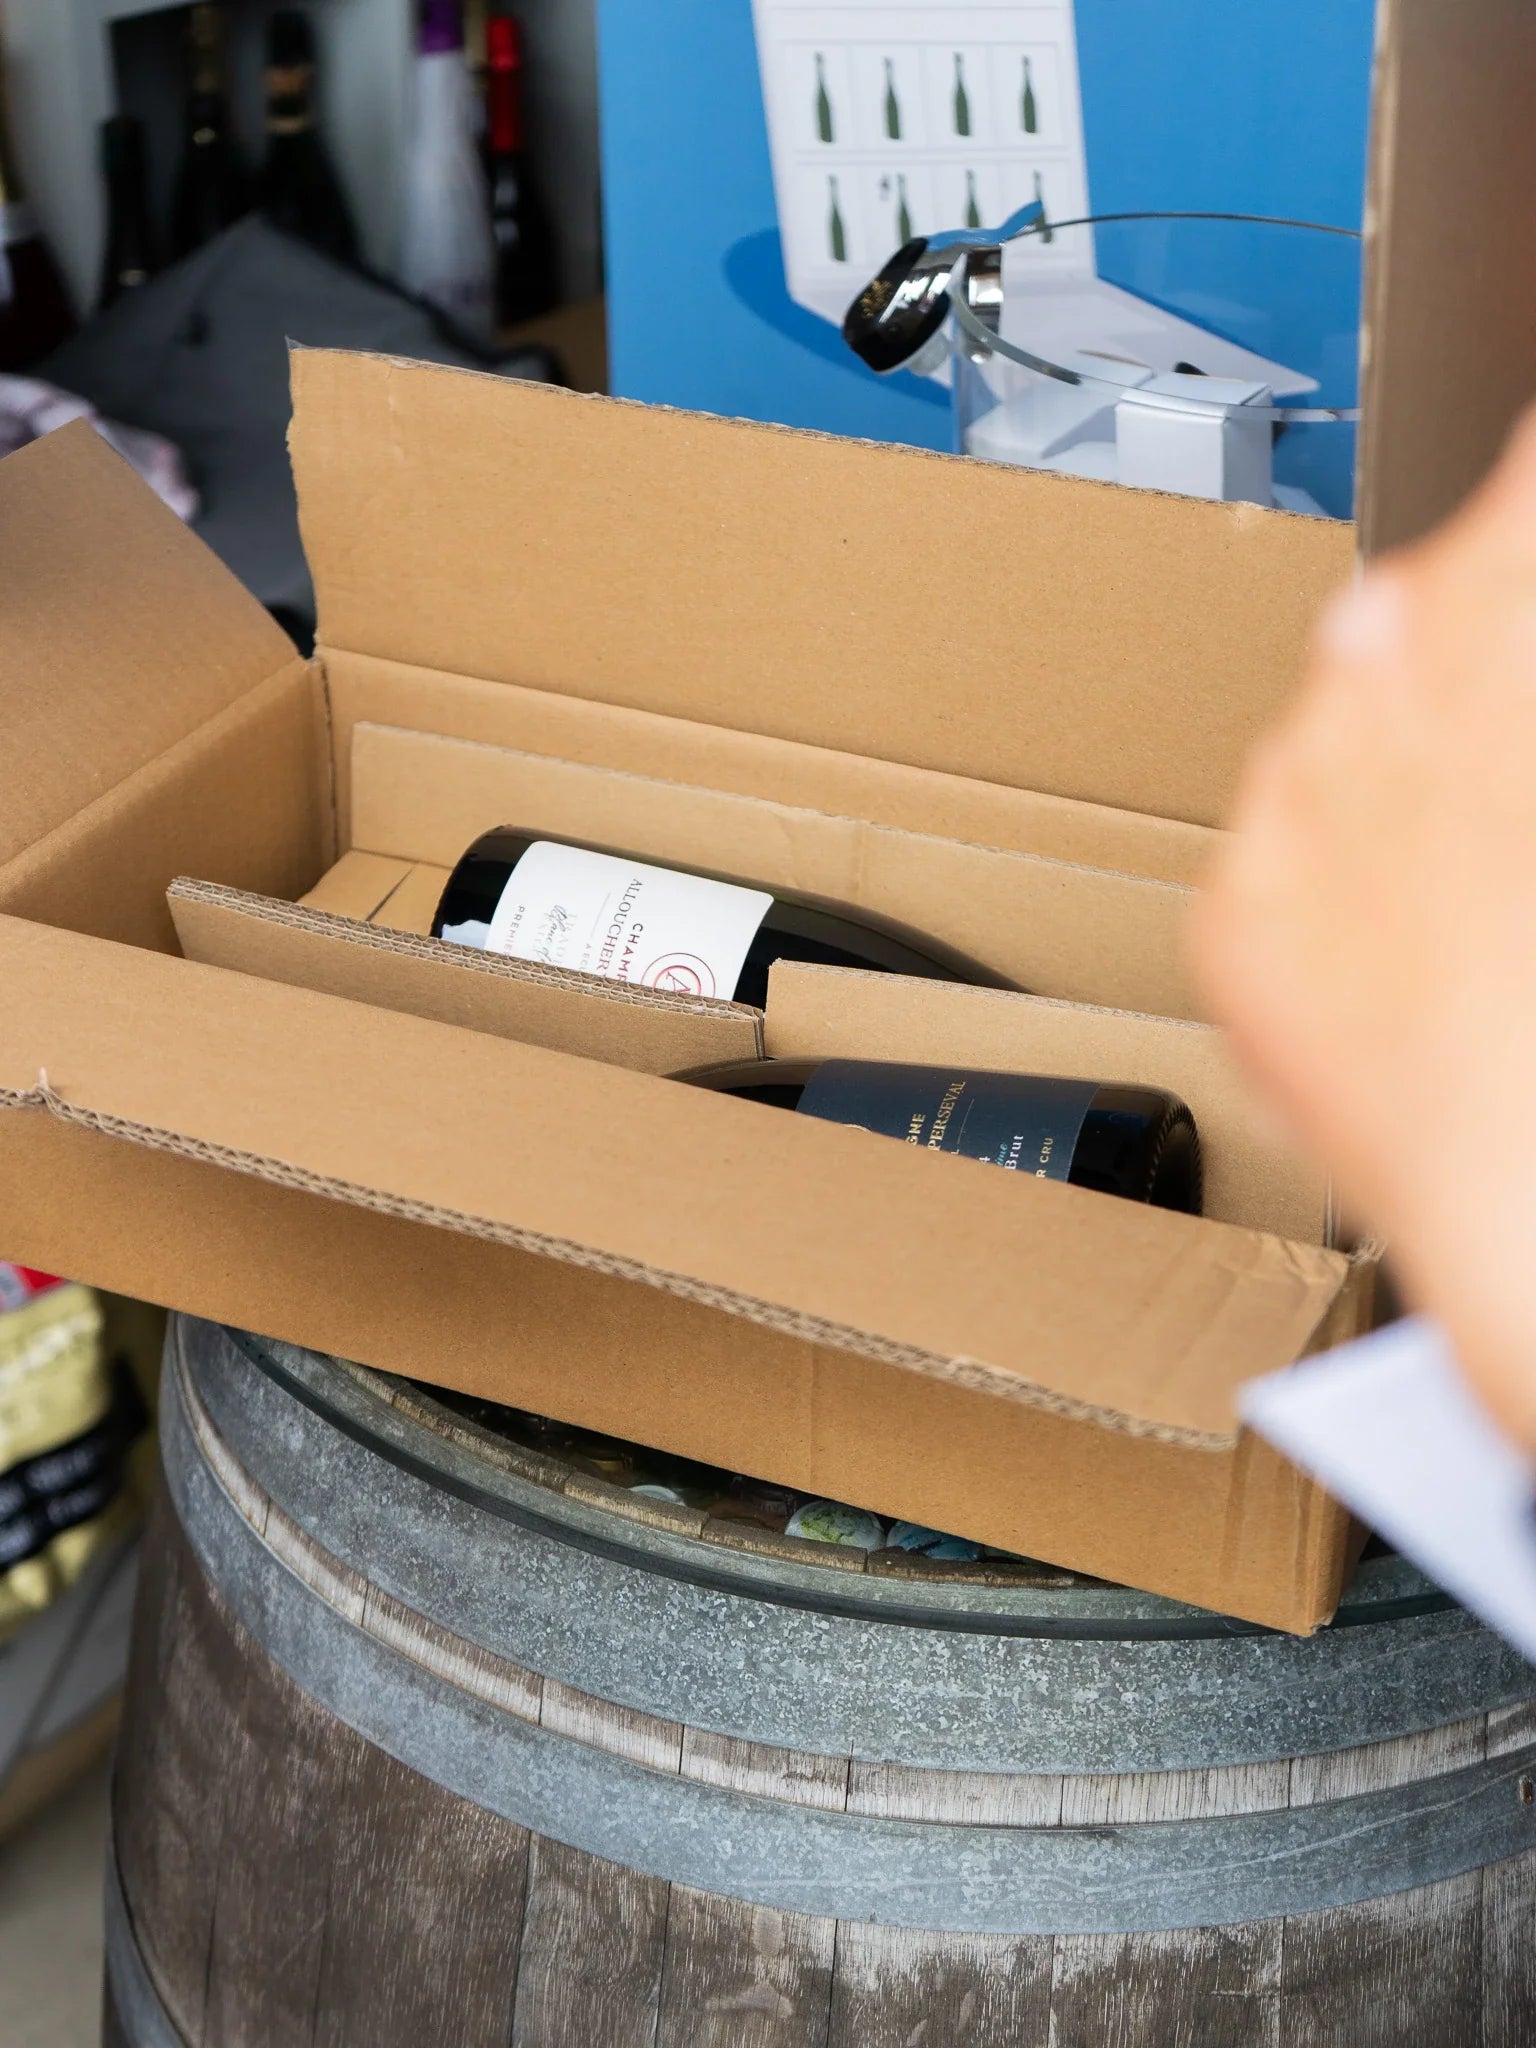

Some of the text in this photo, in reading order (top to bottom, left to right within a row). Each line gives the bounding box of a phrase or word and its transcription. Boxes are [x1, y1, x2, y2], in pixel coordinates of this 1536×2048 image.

[596, 878, 643, 976] ALLOUCHER
[928, 1081, 966, 1151] PERSEVAL
[1004, 1135, 1024, 1170] Brut
[1040, 1137, 1054, 1164] CRU
